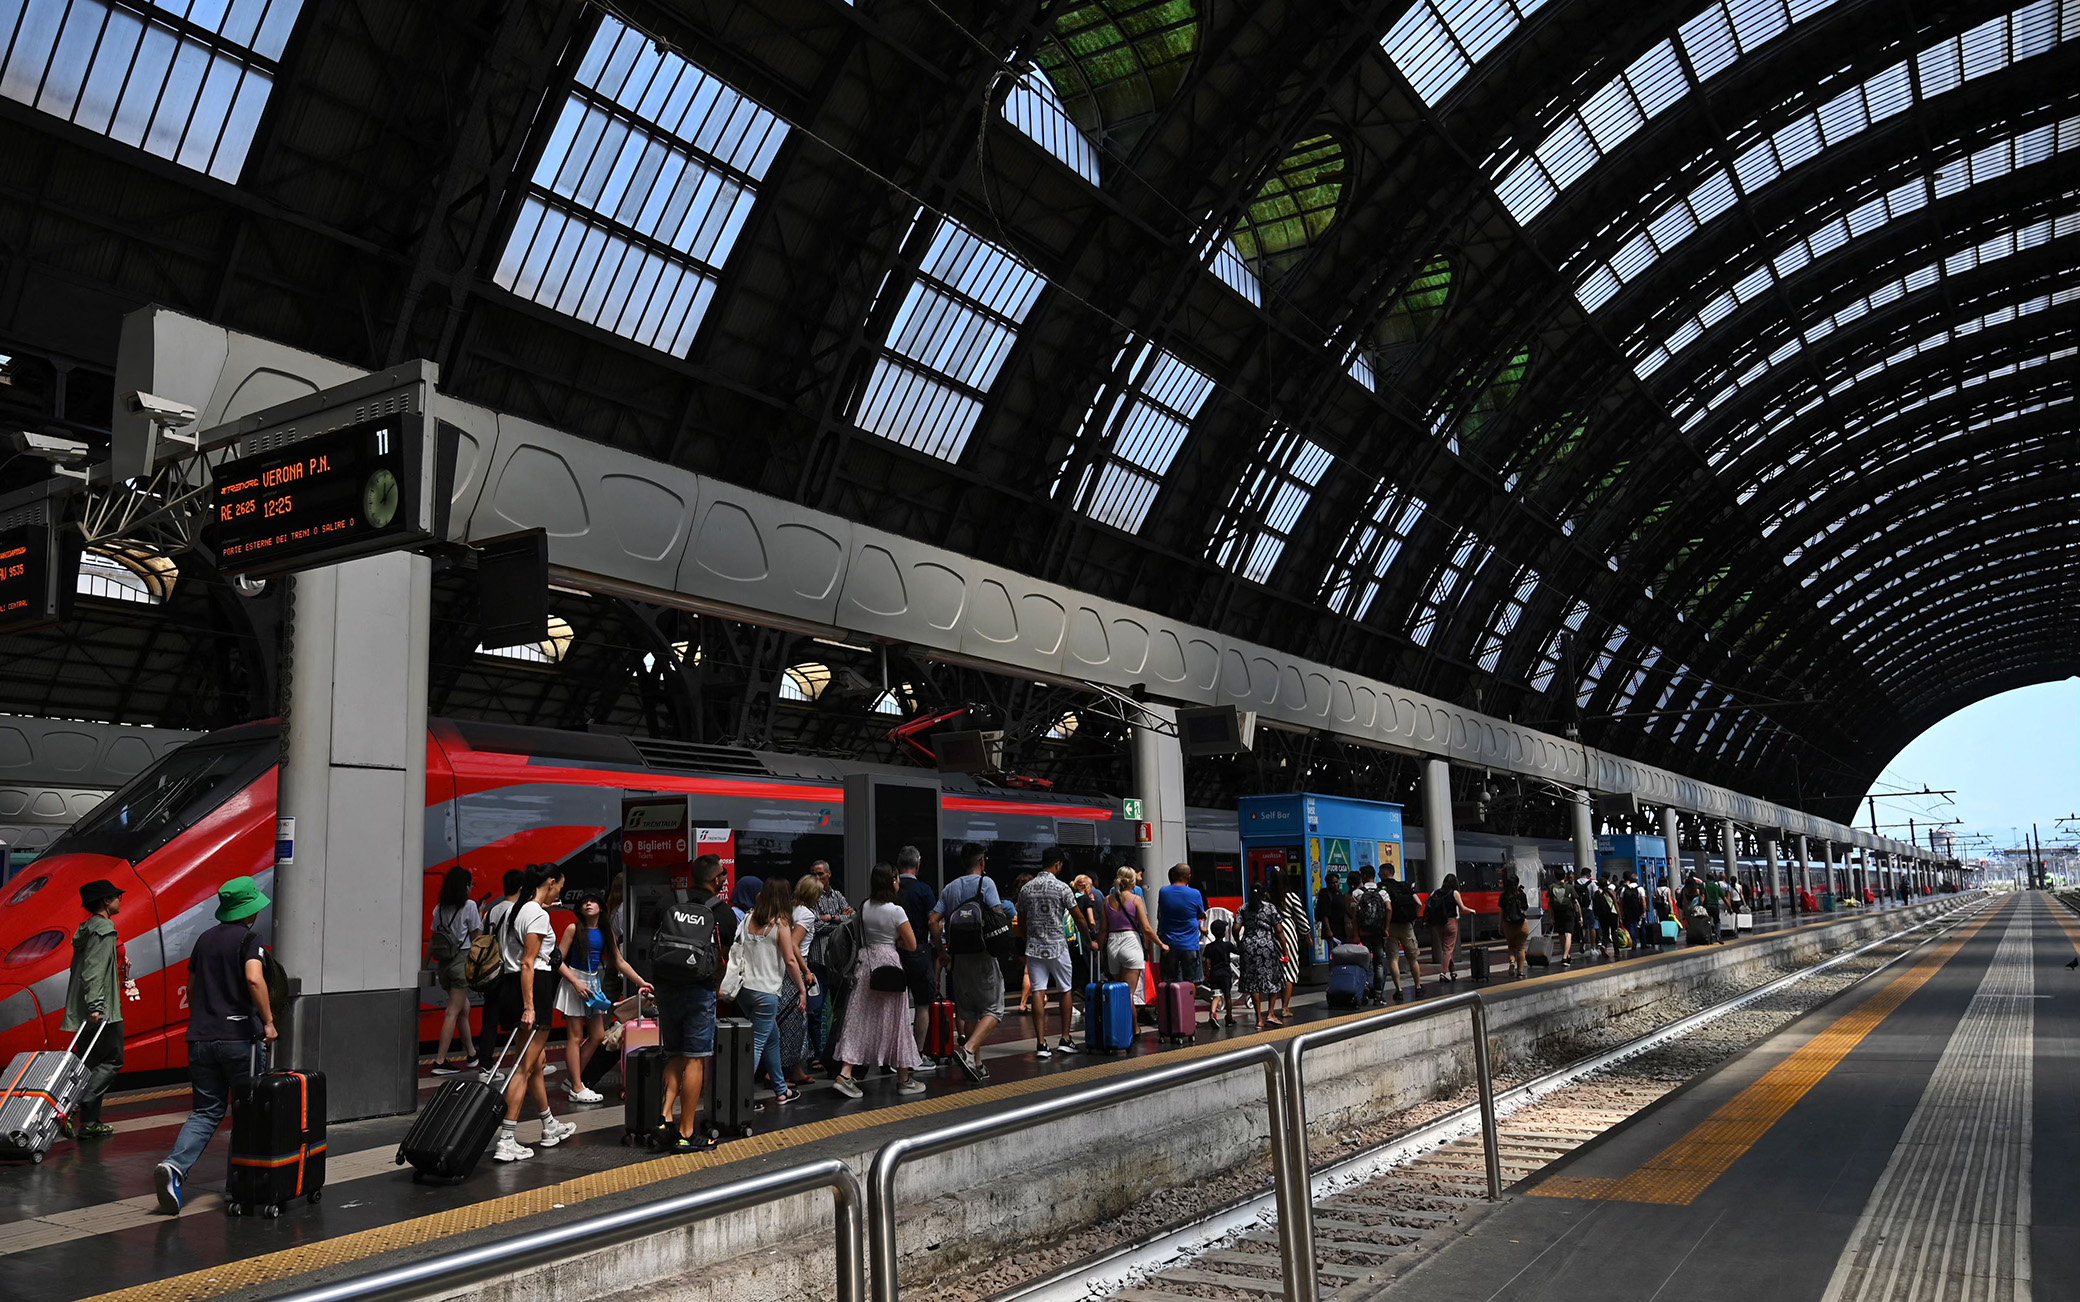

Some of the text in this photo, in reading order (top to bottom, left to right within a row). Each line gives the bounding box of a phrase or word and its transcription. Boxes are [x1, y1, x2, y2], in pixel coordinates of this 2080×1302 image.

[375, 428, 389, 456] 11
[262, 462, 304, 488] VERONA
[309, 455, 331, 476] P.N.
[220, 499, 256, 522] RE 2625
[263, 495, 292, 518] 12:25
[222, 545, 243, 557] PORTE
[245, 538, 273, 552] ESTERNE
[275, 535, 287, 545] DEI
[291, 530, 310, 541] TRENI
[321, 522, 346, 534] SALIRE
[1260, 810, 1291, 820] Self Bar
[637, 839, 672, 853] Biglietti
[638, 852, 654, 860] Tickets
[673, 910, 705, 926] NASA
